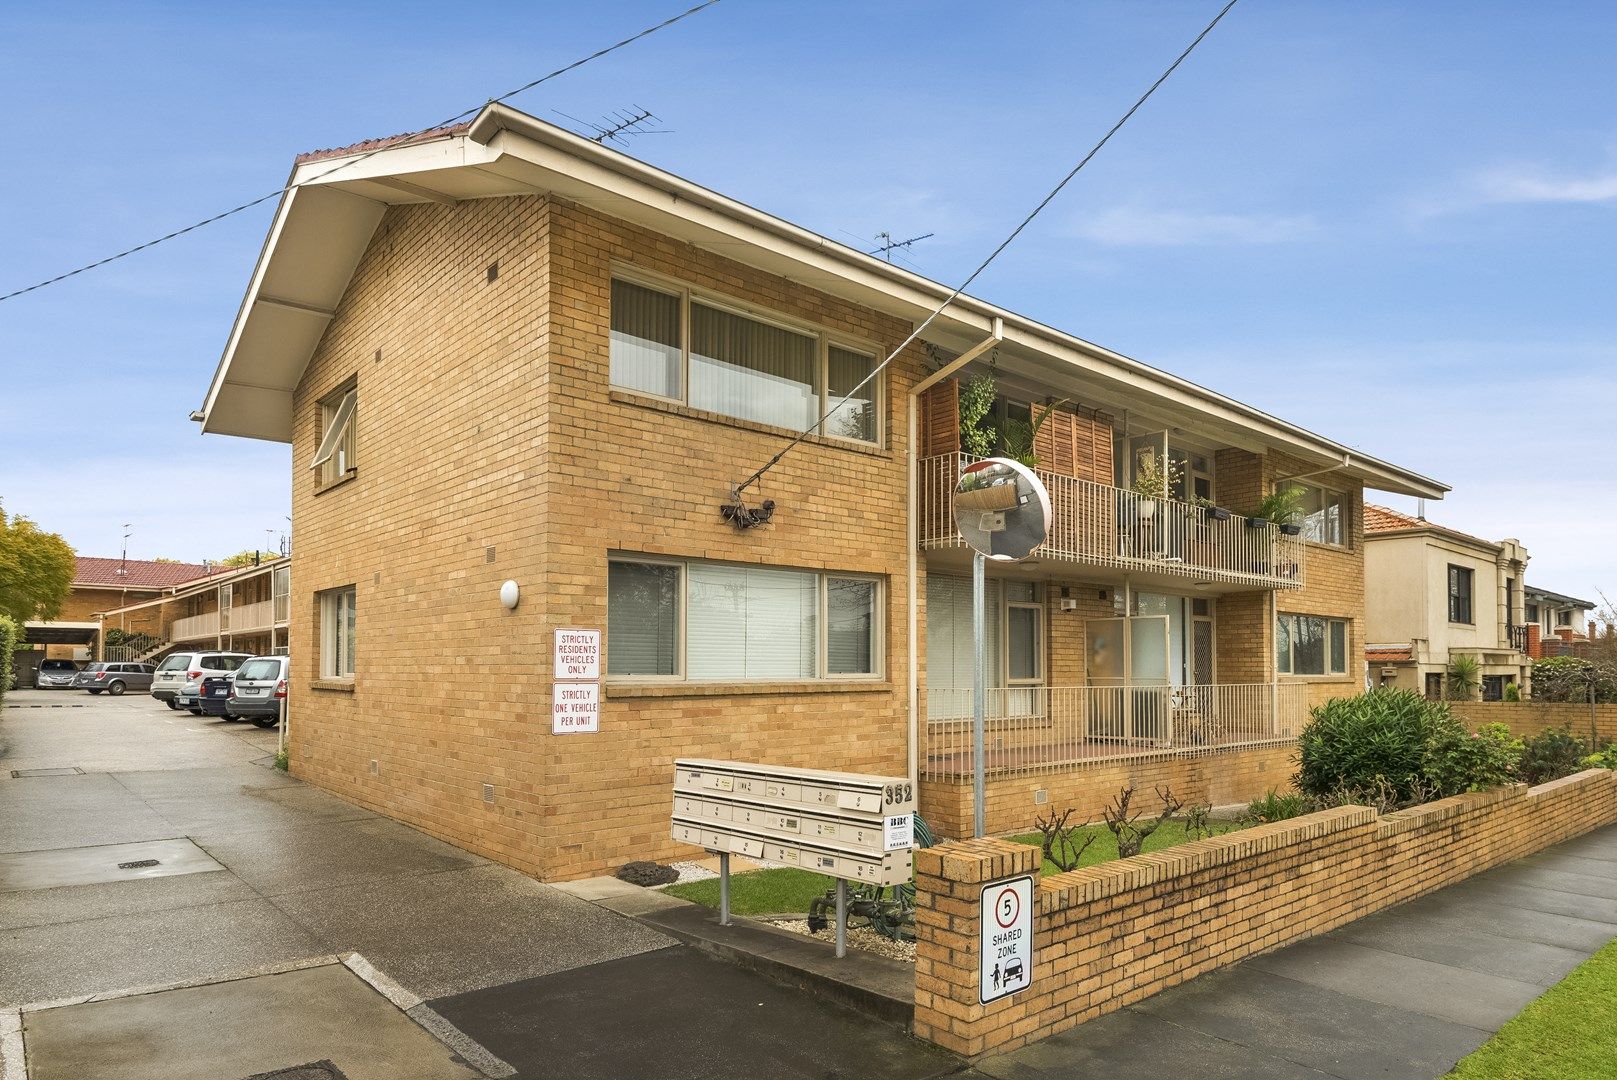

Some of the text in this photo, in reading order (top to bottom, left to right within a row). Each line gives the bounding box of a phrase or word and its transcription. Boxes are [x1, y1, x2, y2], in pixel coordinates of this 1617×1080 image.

[561, 635, 594, 644] STRICTLY
[558, 645, 597, 654] RESIDENTS
[560, 655, 595, 664] VEHICLES
[567, 665, 587, 674] ONLY
[561, 690, 591, 700] STRICTLY
[555, 702, 597, 713] ONE VEHICLE
[561, 716, 591, 726] PER UNIT
[885, 783, 912, 805] 352
[1004, 899, 1012, 917] 5
[992, 928, 1022, 947] SHARED
[997, 943, 1017, 959] ZONE
